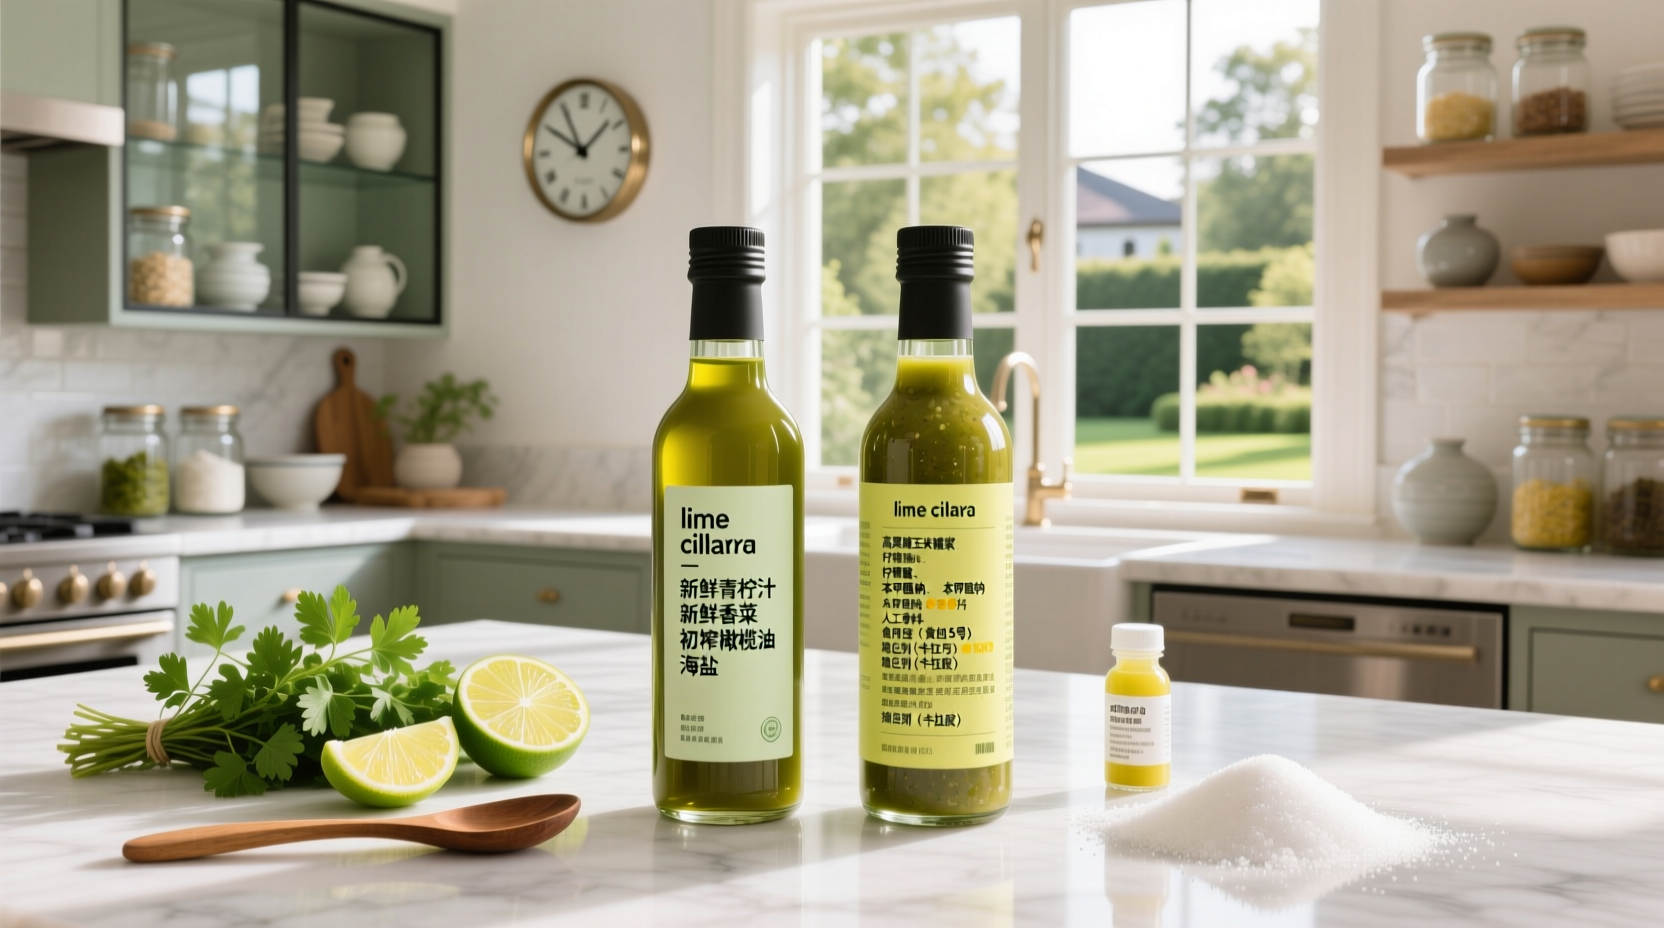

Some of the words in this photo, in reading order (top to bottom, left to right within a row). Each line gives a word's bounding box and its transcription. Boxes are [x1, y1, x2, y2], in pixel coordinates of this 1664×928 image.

[681, 507, 730, 529] lime
[894, 501, 927, 517] lime
[931, 501, 976, 517] cilara
[680, 533, 756, 554] cillarra
[680, 577, 776, 599] 新鲜青柠汁
[680, 603, 758, 625] 新鲜香菜
[680, 654, 718, 676] 海盐
